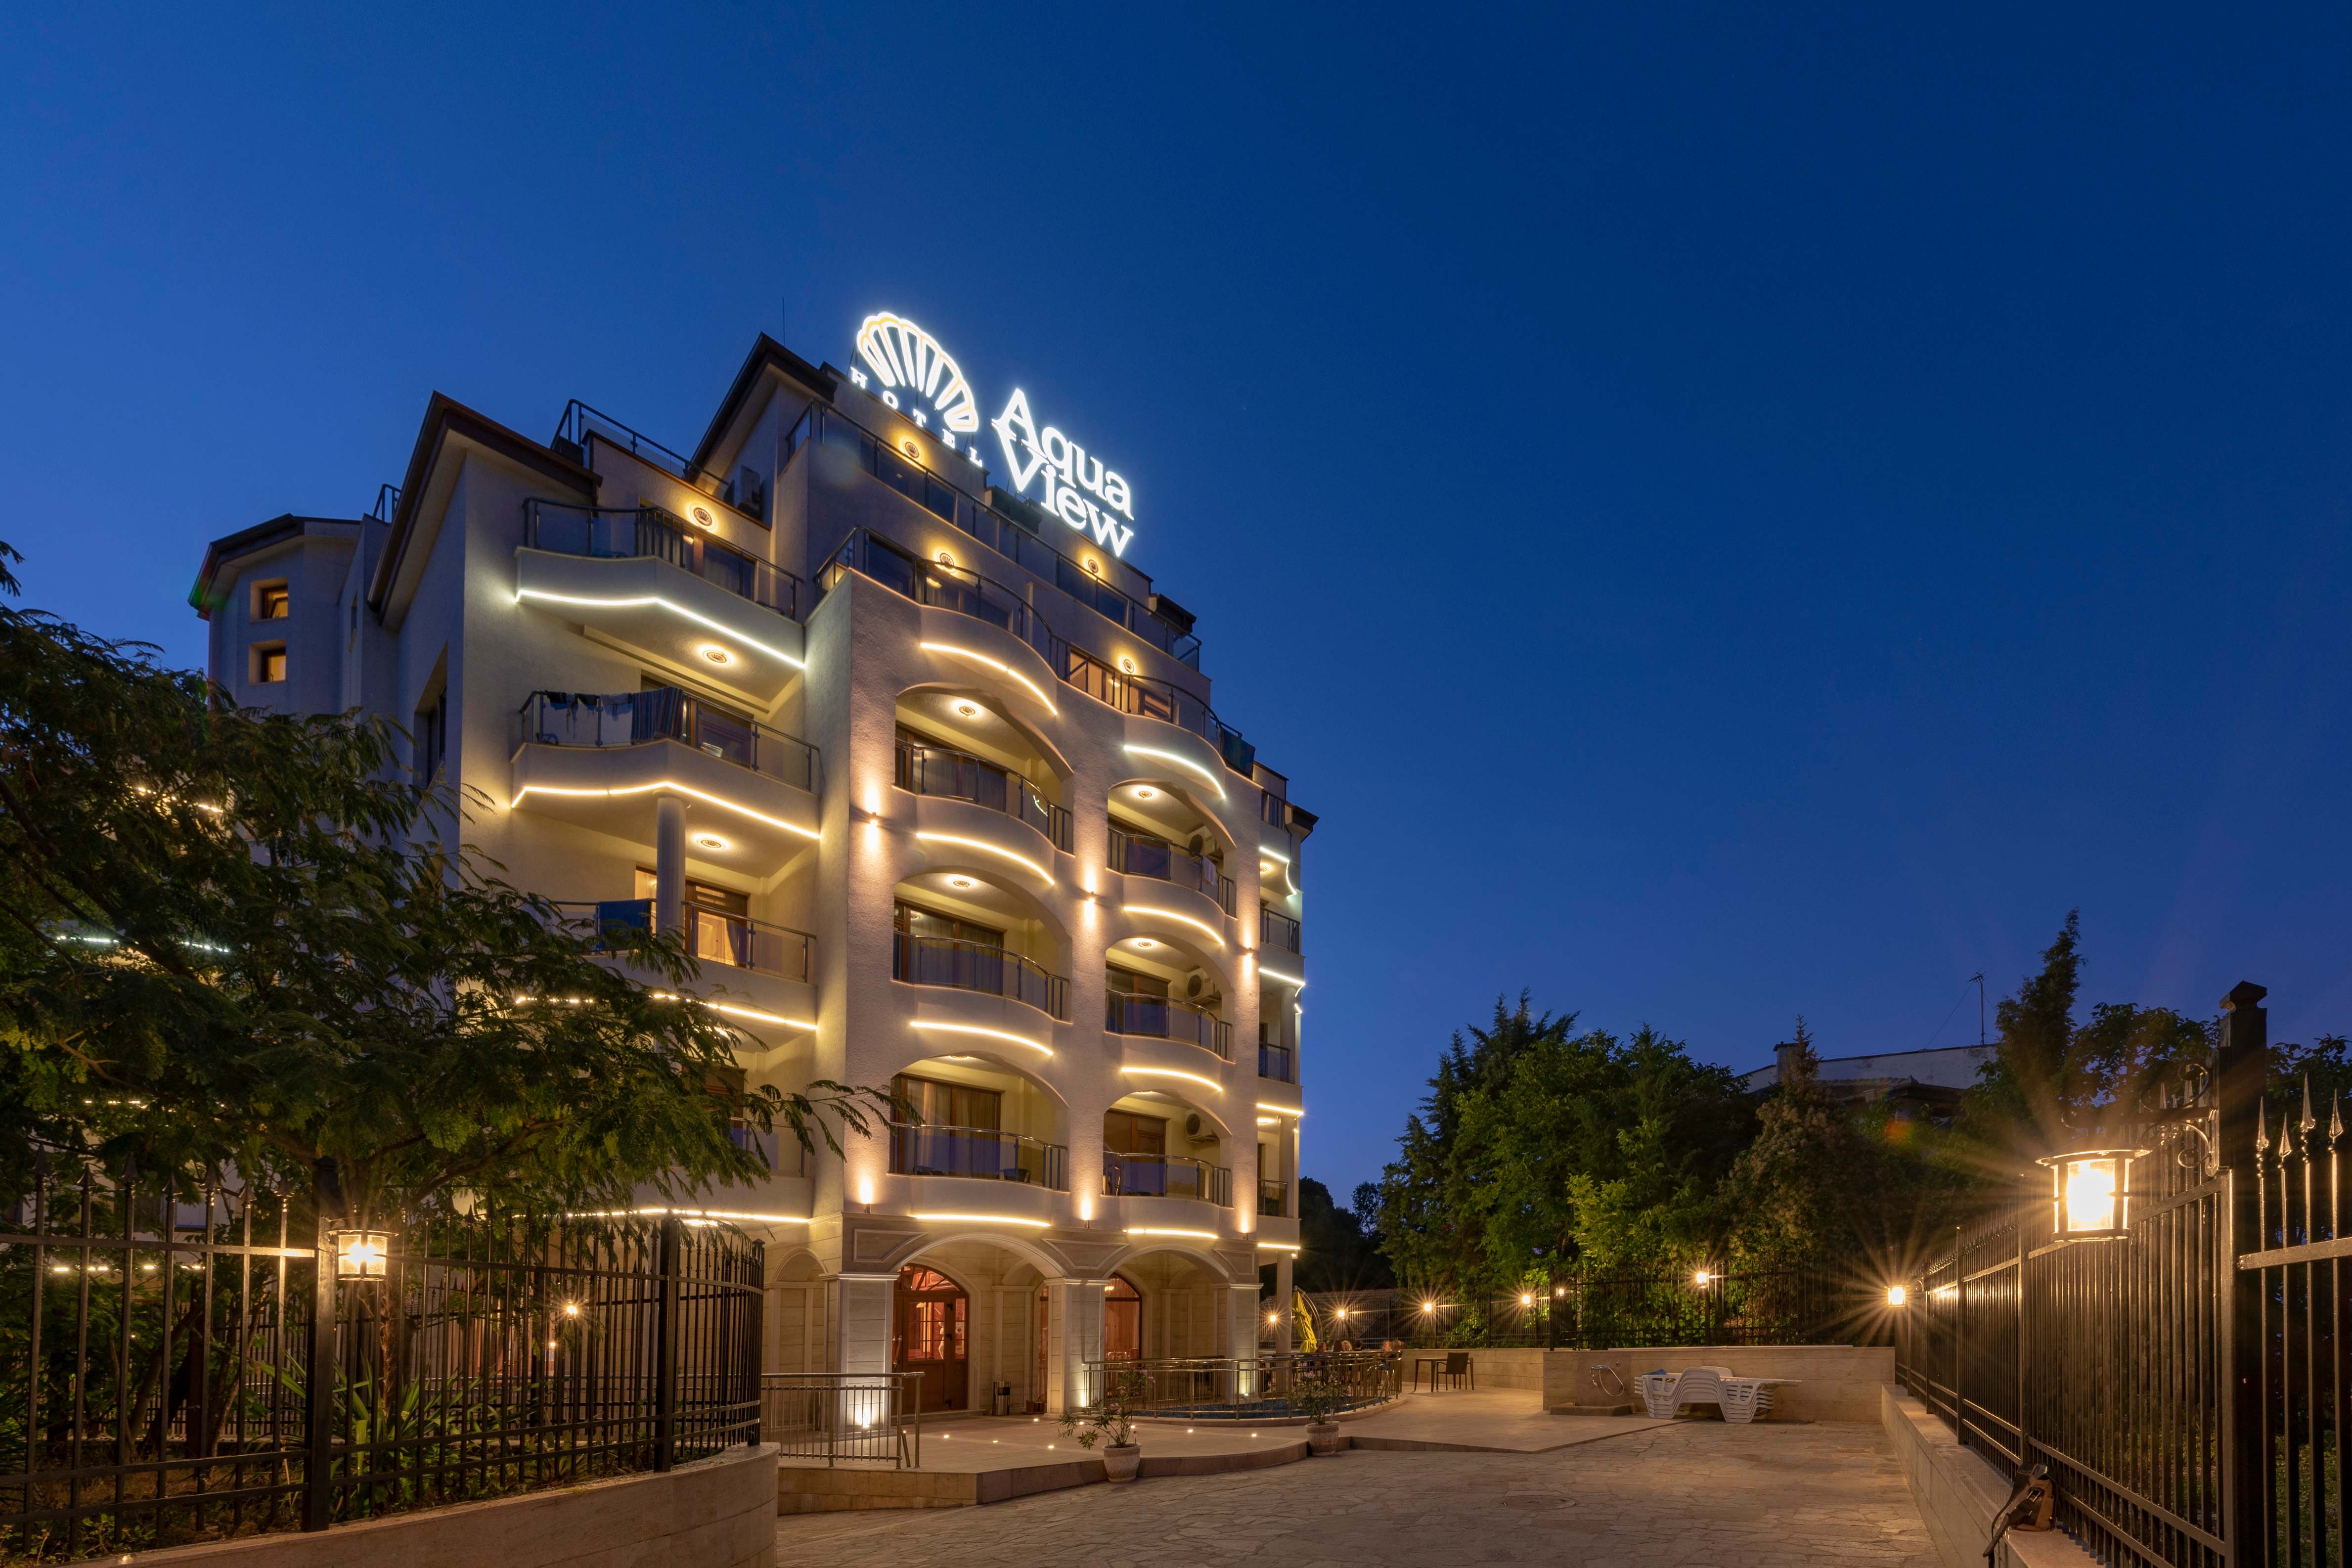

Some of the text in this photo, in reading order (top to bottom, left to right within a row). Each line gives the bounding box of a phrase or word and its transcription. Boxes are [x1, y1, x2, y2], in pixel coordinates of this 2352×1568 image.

[851, 367, 982, 467] HOTEL
[991, 388, 1134, 520] Aqua
[991, 421, 1133, 557] View
